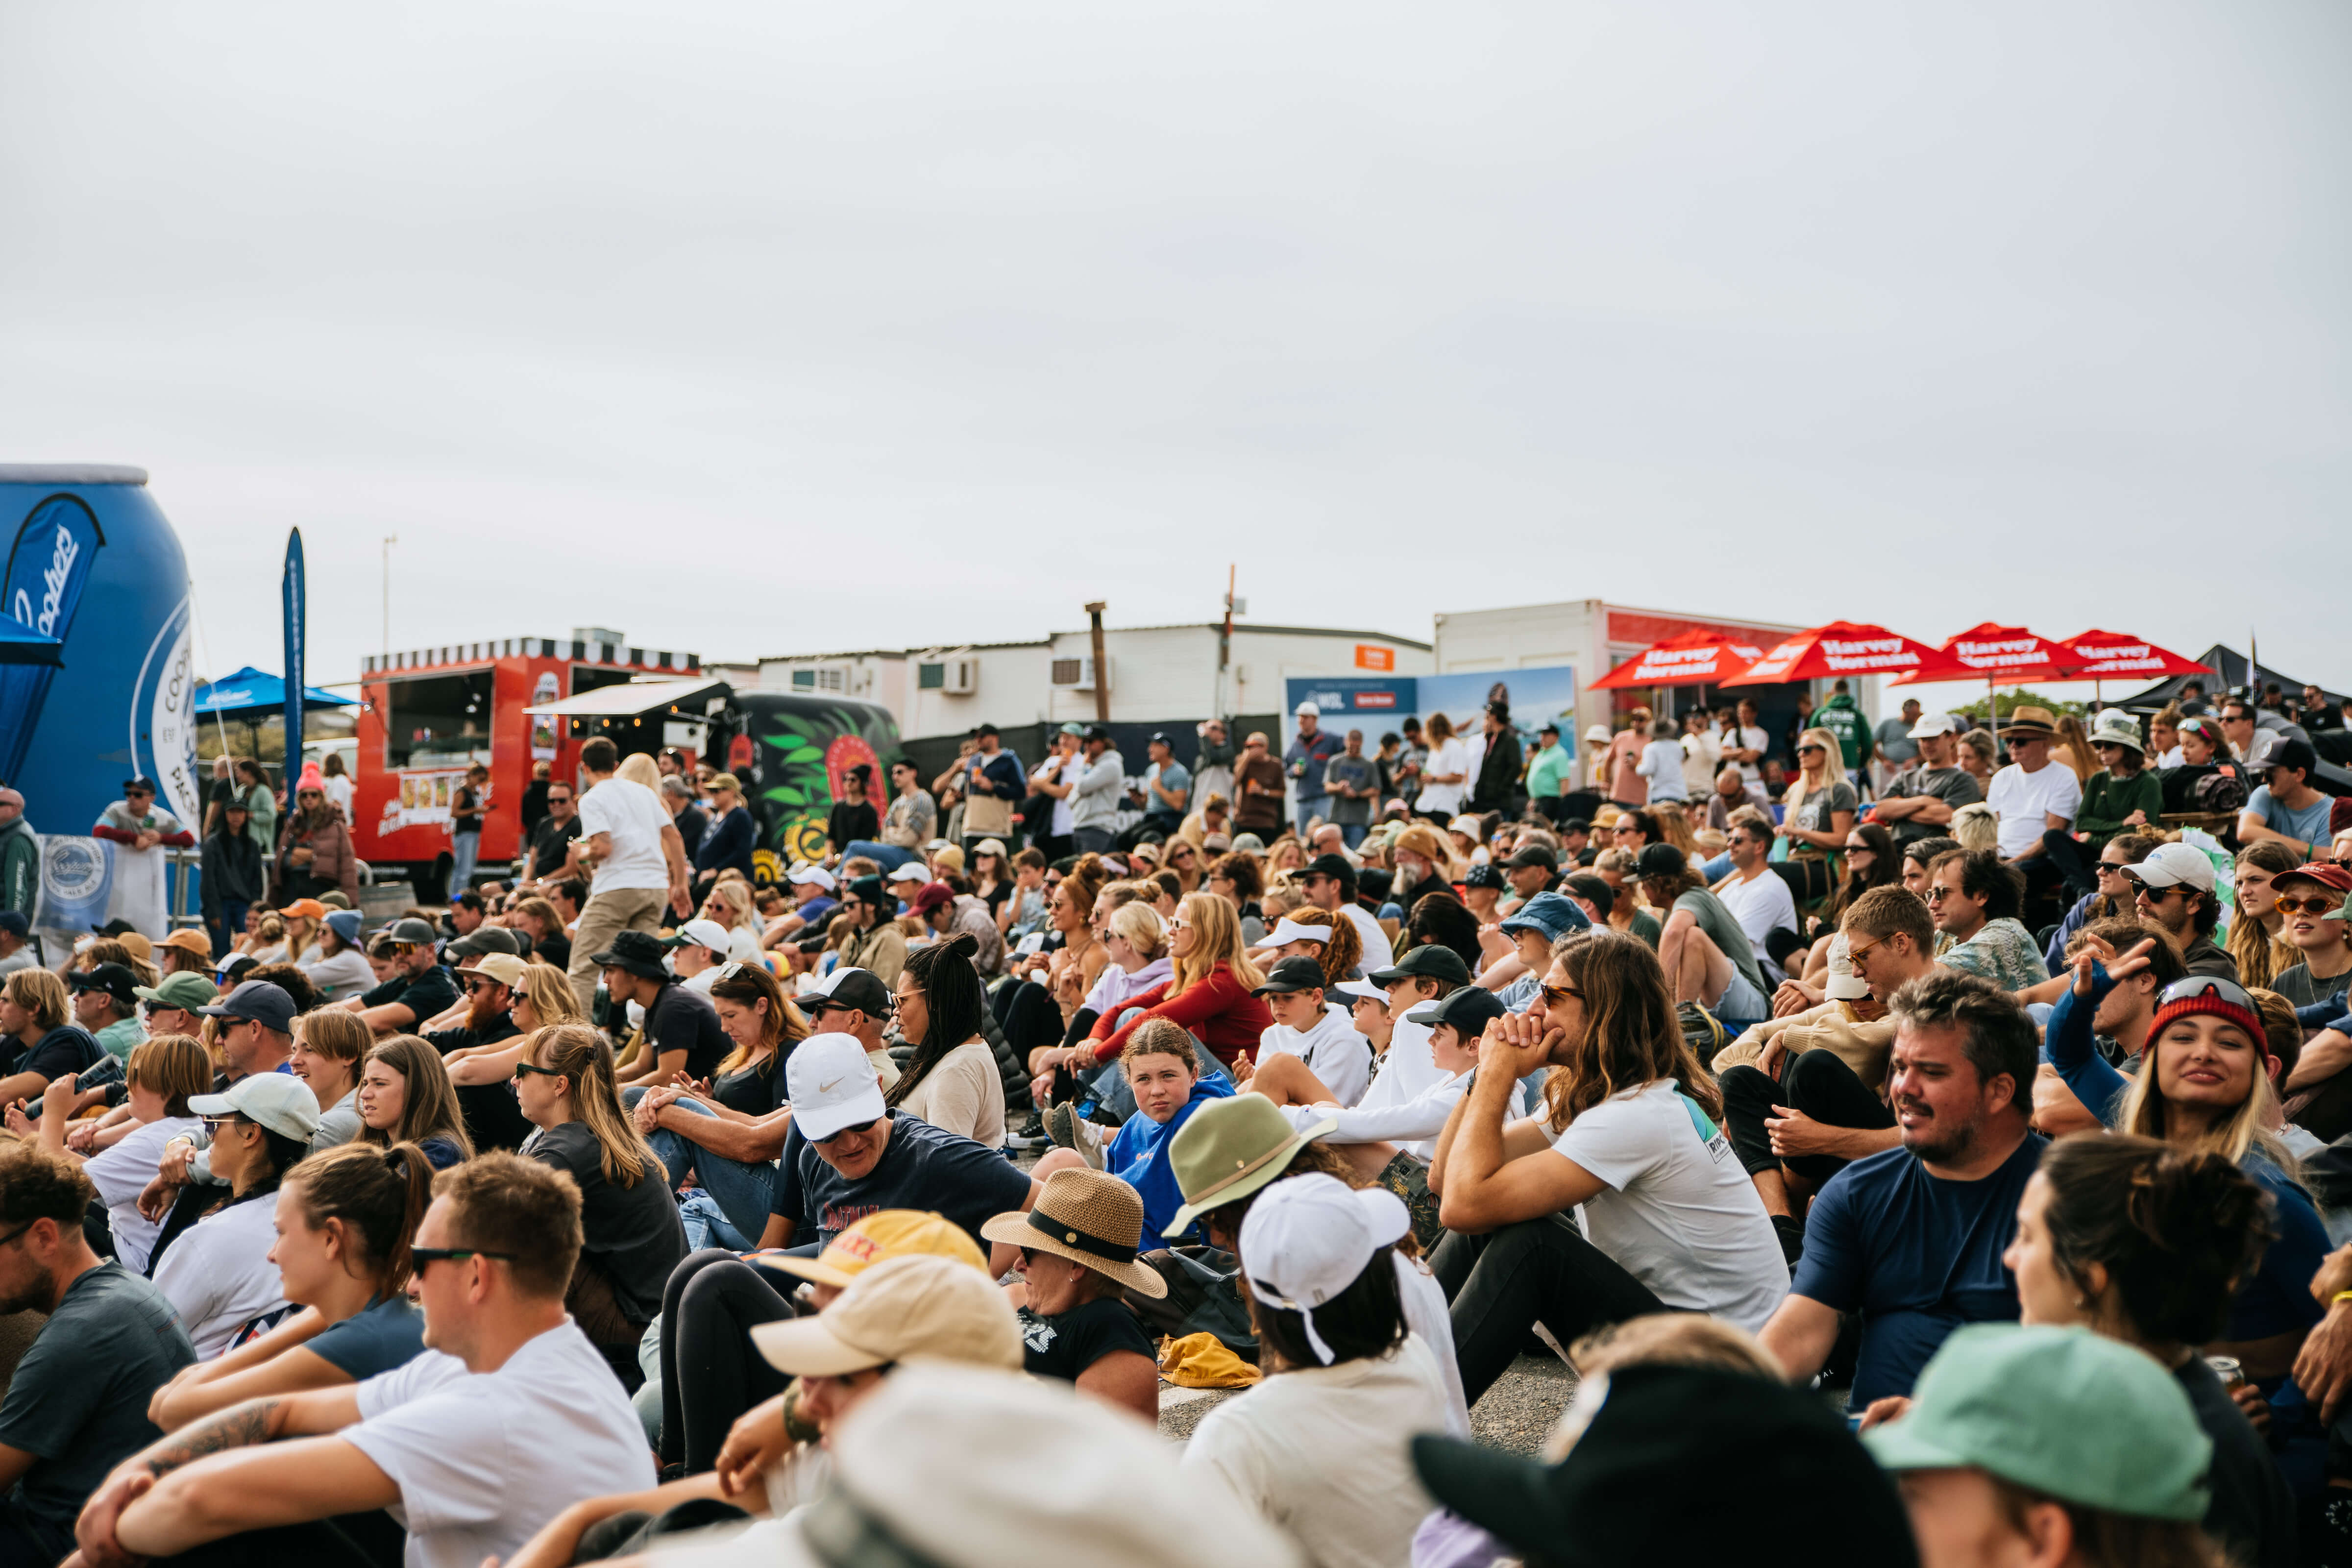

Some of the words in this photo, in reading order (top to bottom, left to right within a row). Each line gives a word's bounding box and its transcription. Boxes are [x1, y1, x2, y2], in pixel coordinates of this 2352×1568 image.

[1820, 638, 1903, 655] Harvey
[1955, 638, 2038, 655] Harvey
[2075, 645, 2150, 659] Harvey
[1643, 647, 1719, 665] Harvey
[1825, 651, 1921, 670] Norman
[1633, 659, 1718, 680] Norman
